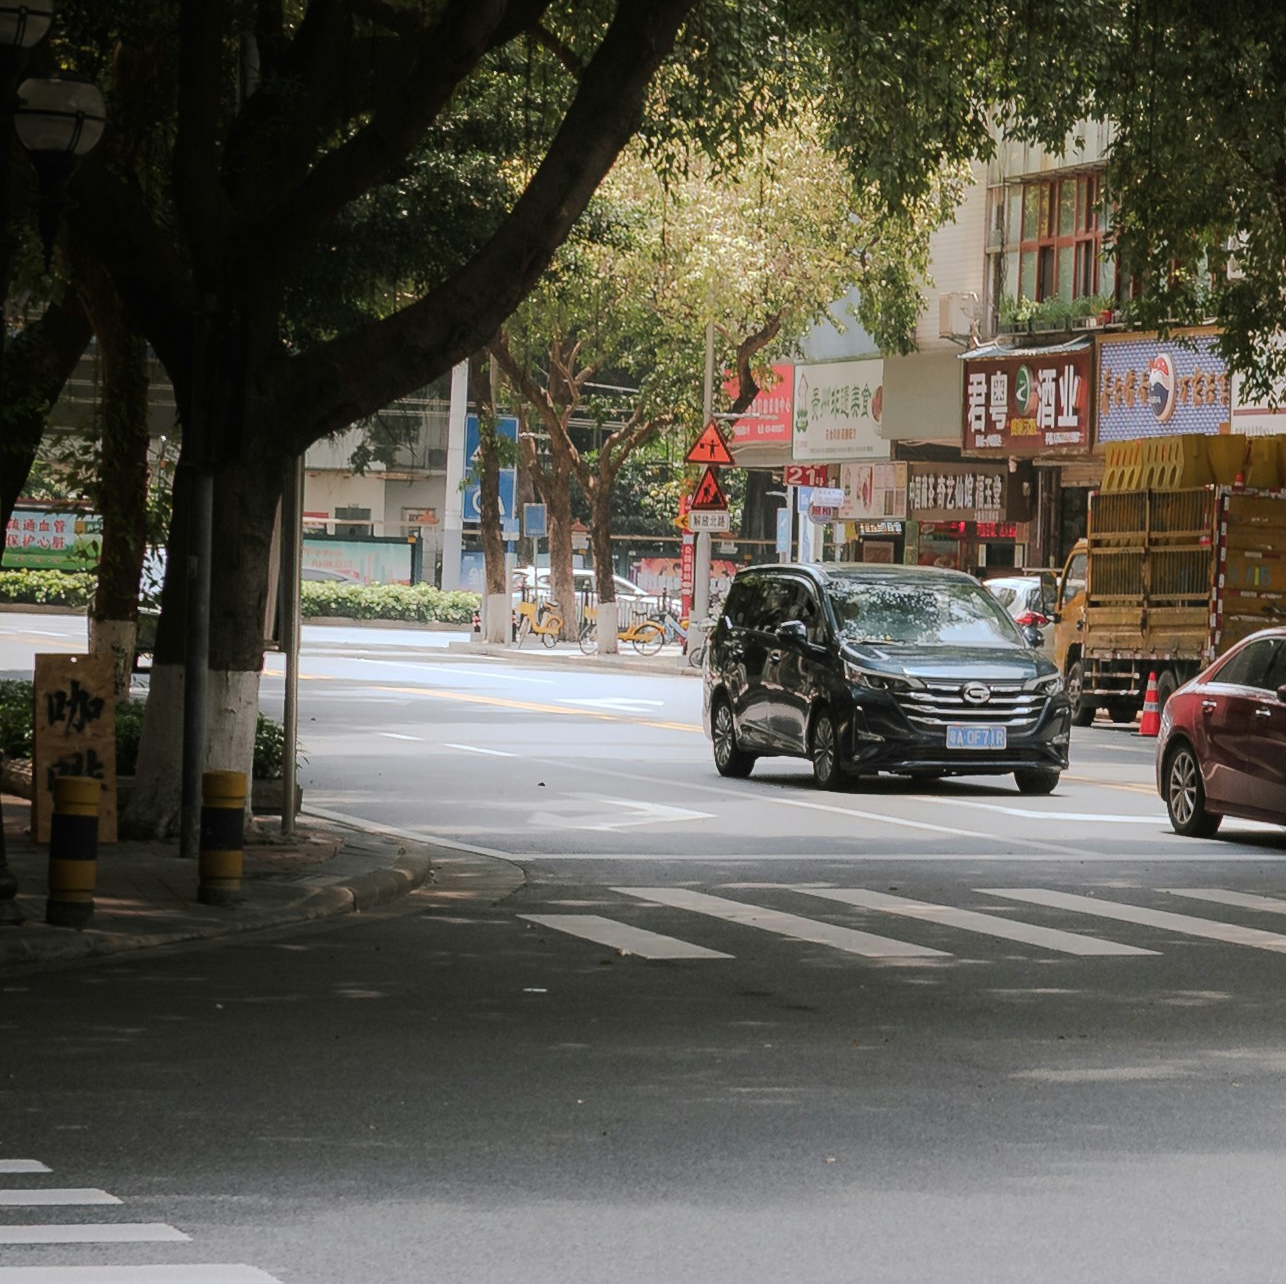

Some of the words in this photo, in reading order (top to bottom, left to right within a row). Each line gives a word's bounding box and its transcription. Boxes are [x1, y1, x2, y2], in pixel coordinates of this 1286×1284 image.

[967, 370, 1008, 433] 君粤
[1037, 364, 1079, 429] 酒业
[693, 515, 726, 528] 解放北路
